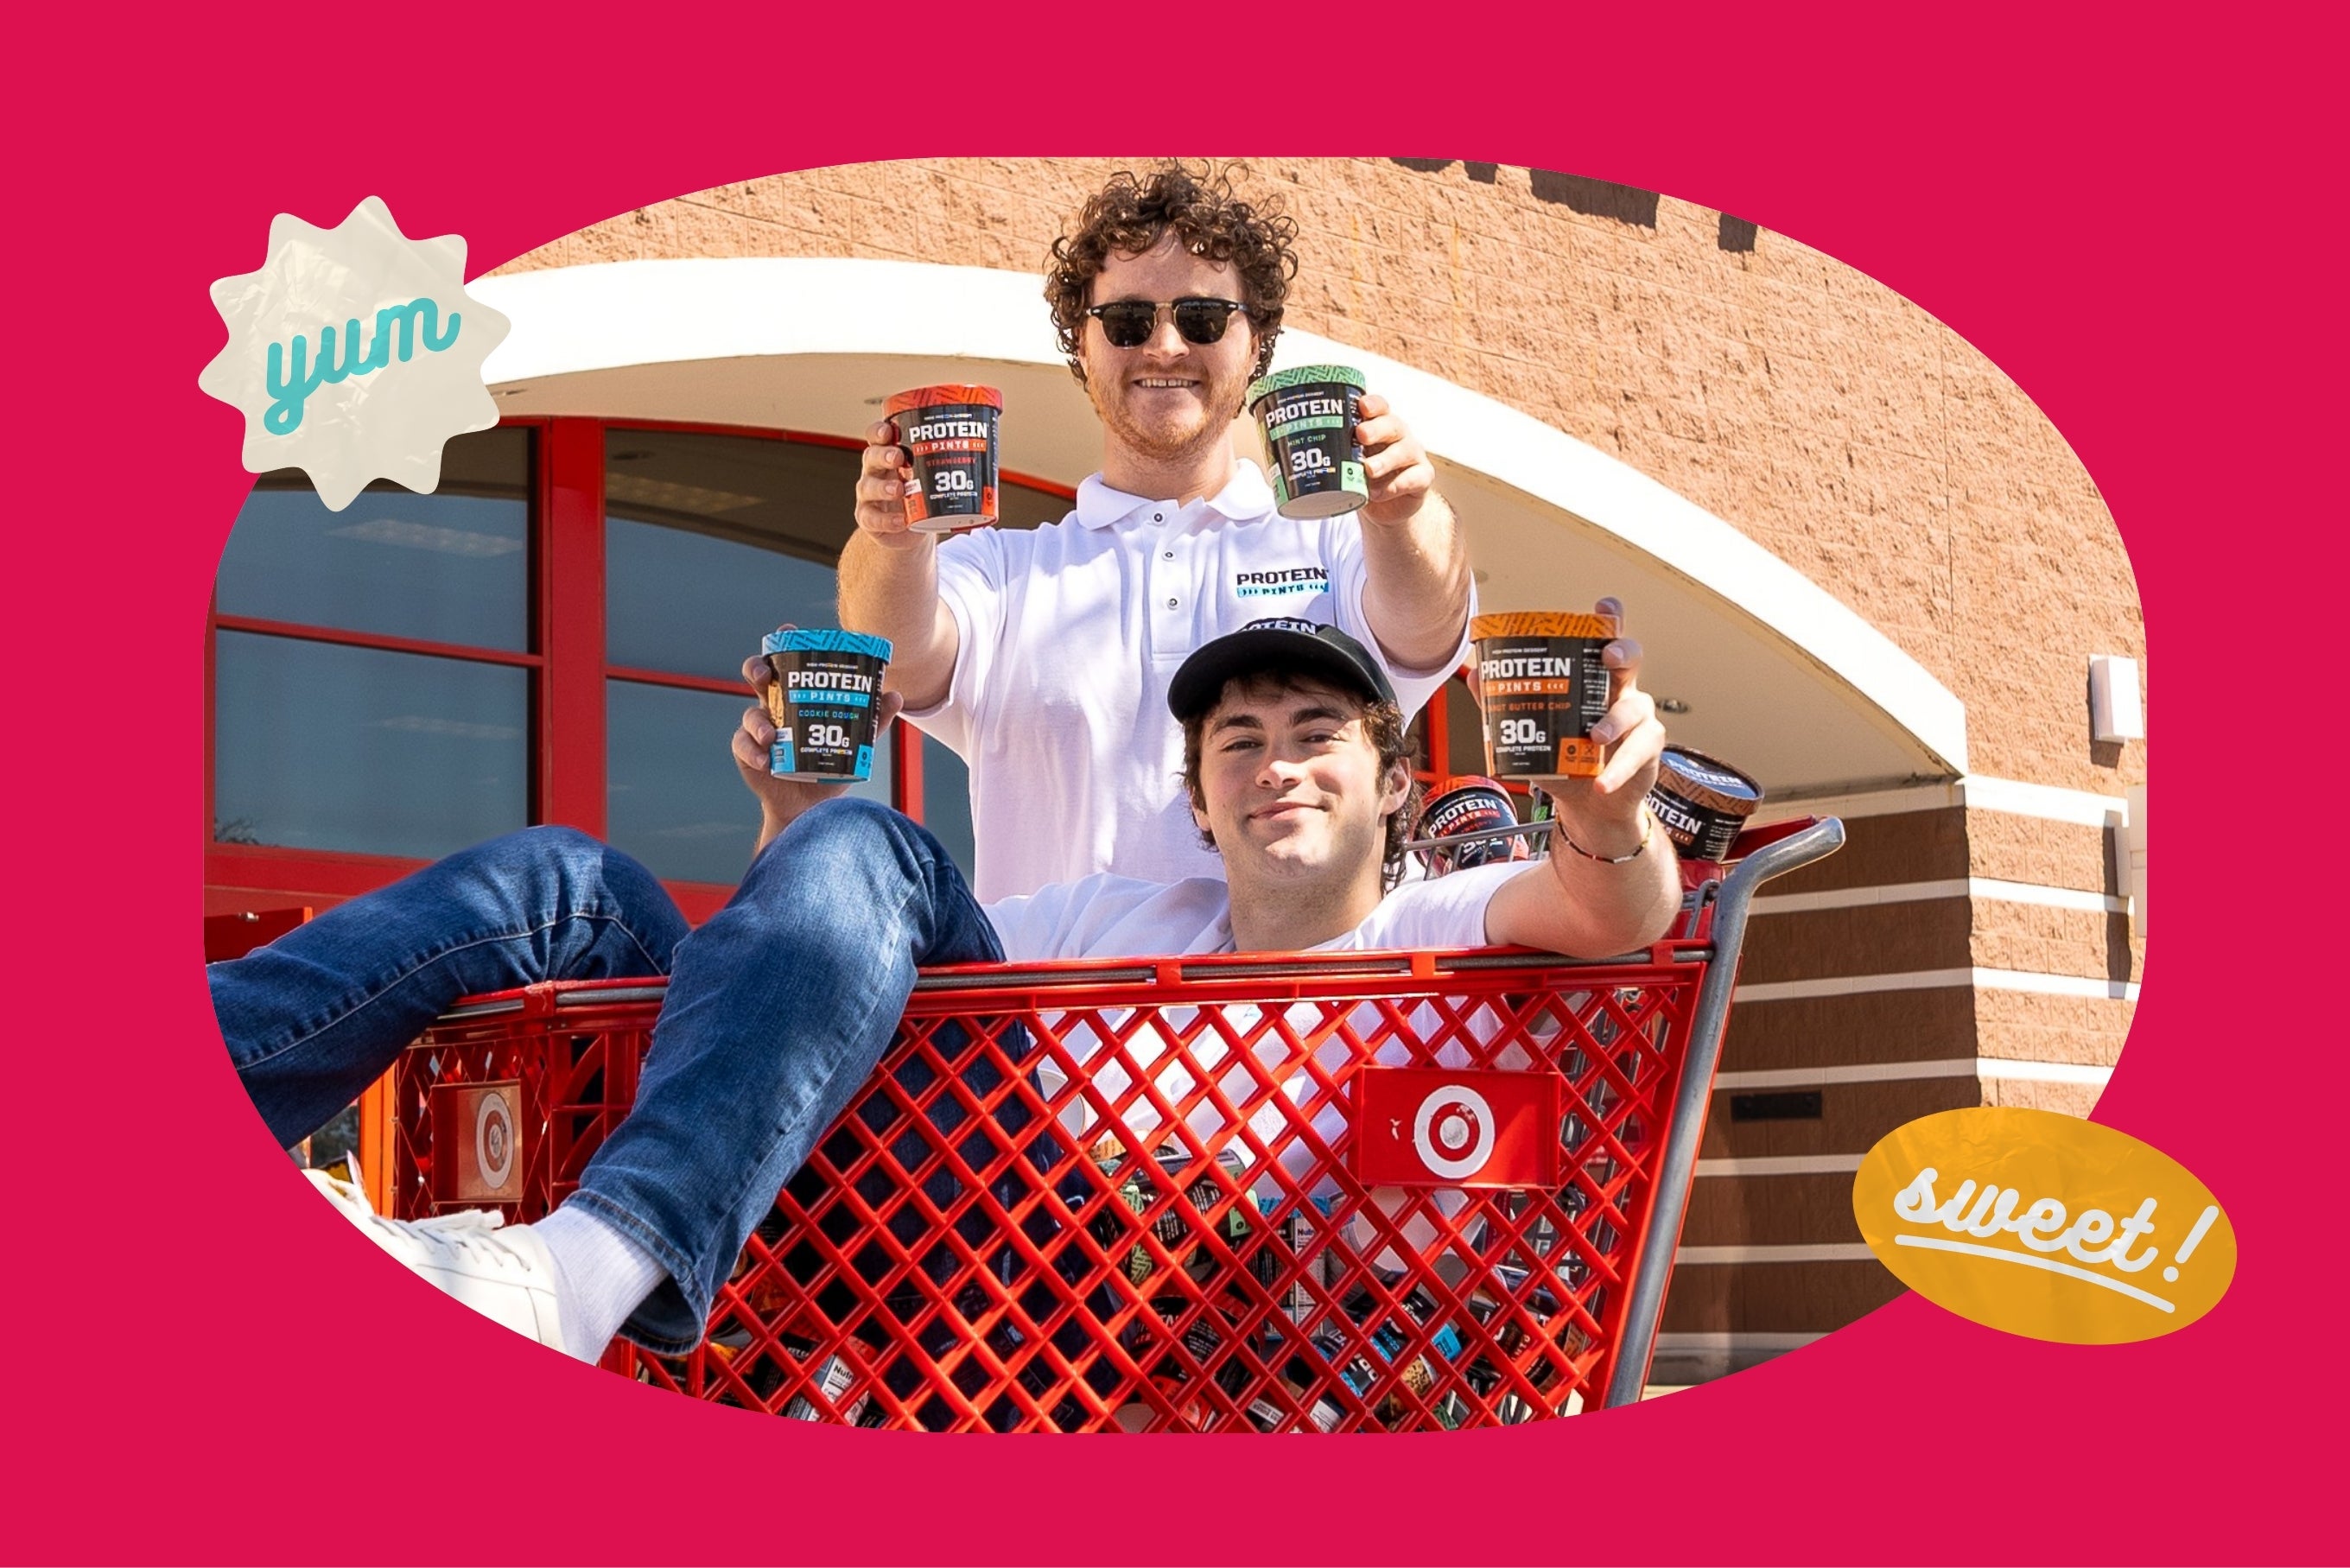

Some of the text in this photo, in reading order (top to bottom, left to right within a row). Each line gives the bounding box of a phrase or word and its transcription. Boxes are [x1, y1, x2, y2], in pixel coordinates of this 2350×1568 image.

[1265, 399, 1343, 429] PROTEIN
[909, 422, 988, 444] PROTEIN
[1307, 434, 1327, 443] CHIP
[931, 440, 969, 451] PINTS
[1291, 448, 1331, 473] 30G
[934, 469, 975, 492] 30G
[1236, 567, 1328, 586] PROTEIN
[1261, 584, 1305, 595] PINTS
[1242, 619, 1317, 636] OTEIN
[1481, 657, 1572, 680] PROTEIN
[788, 671, 873, 693] PROTEIN
[1497, 682, 1542, 693] PINTS
[810, 692, 851, 703] PINTS
[1548, 701, 1572, 710] CHIP
[798, 709, 860, 720] COOKIE DOUGH
[808, 724, 851, 748] 30G
[1500, 719, 1547, 745] 30G
[1428, 798, 1498, 839] PROTEIN
